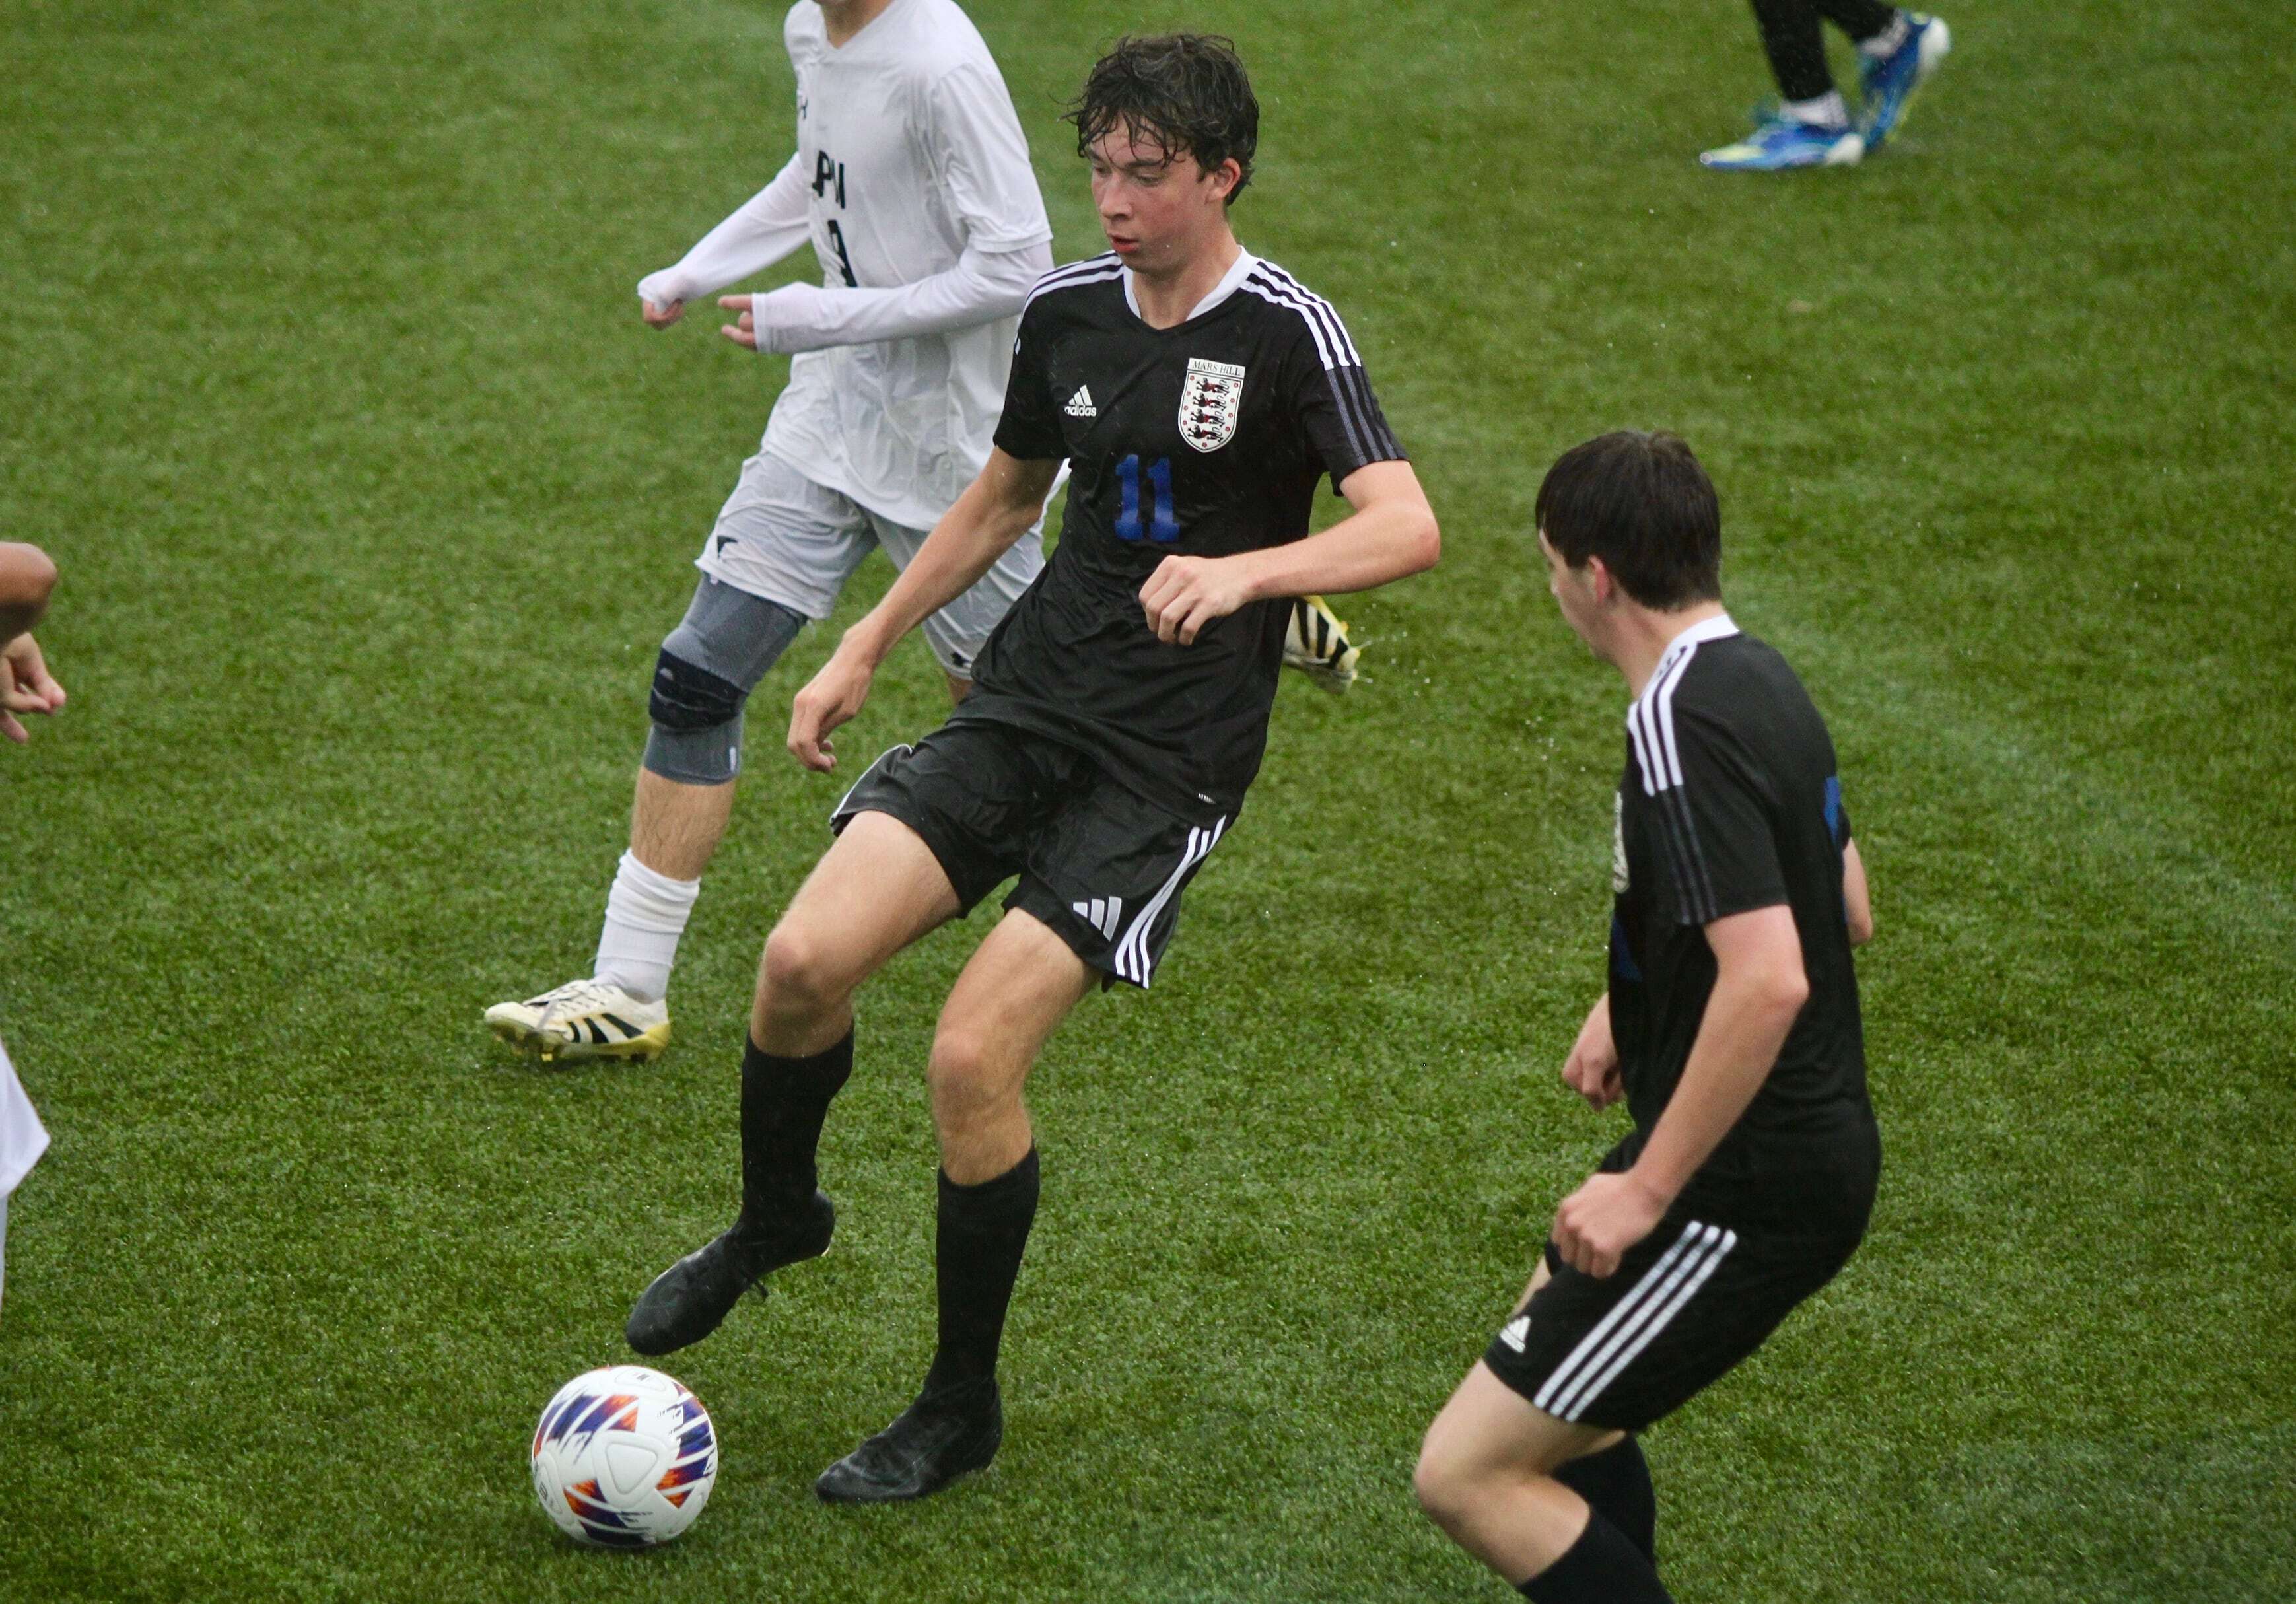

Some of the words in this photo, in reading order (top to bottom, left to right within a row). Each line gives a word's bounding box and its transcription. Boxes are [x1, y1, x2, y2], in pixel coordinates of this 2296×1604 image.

[1193, 361, 1218, 372] MARS
[1219, 365, 1241, 376] HILL
[1064, 403, 1097, 417] adidas
[1115, 454, 1180, 542] 11
